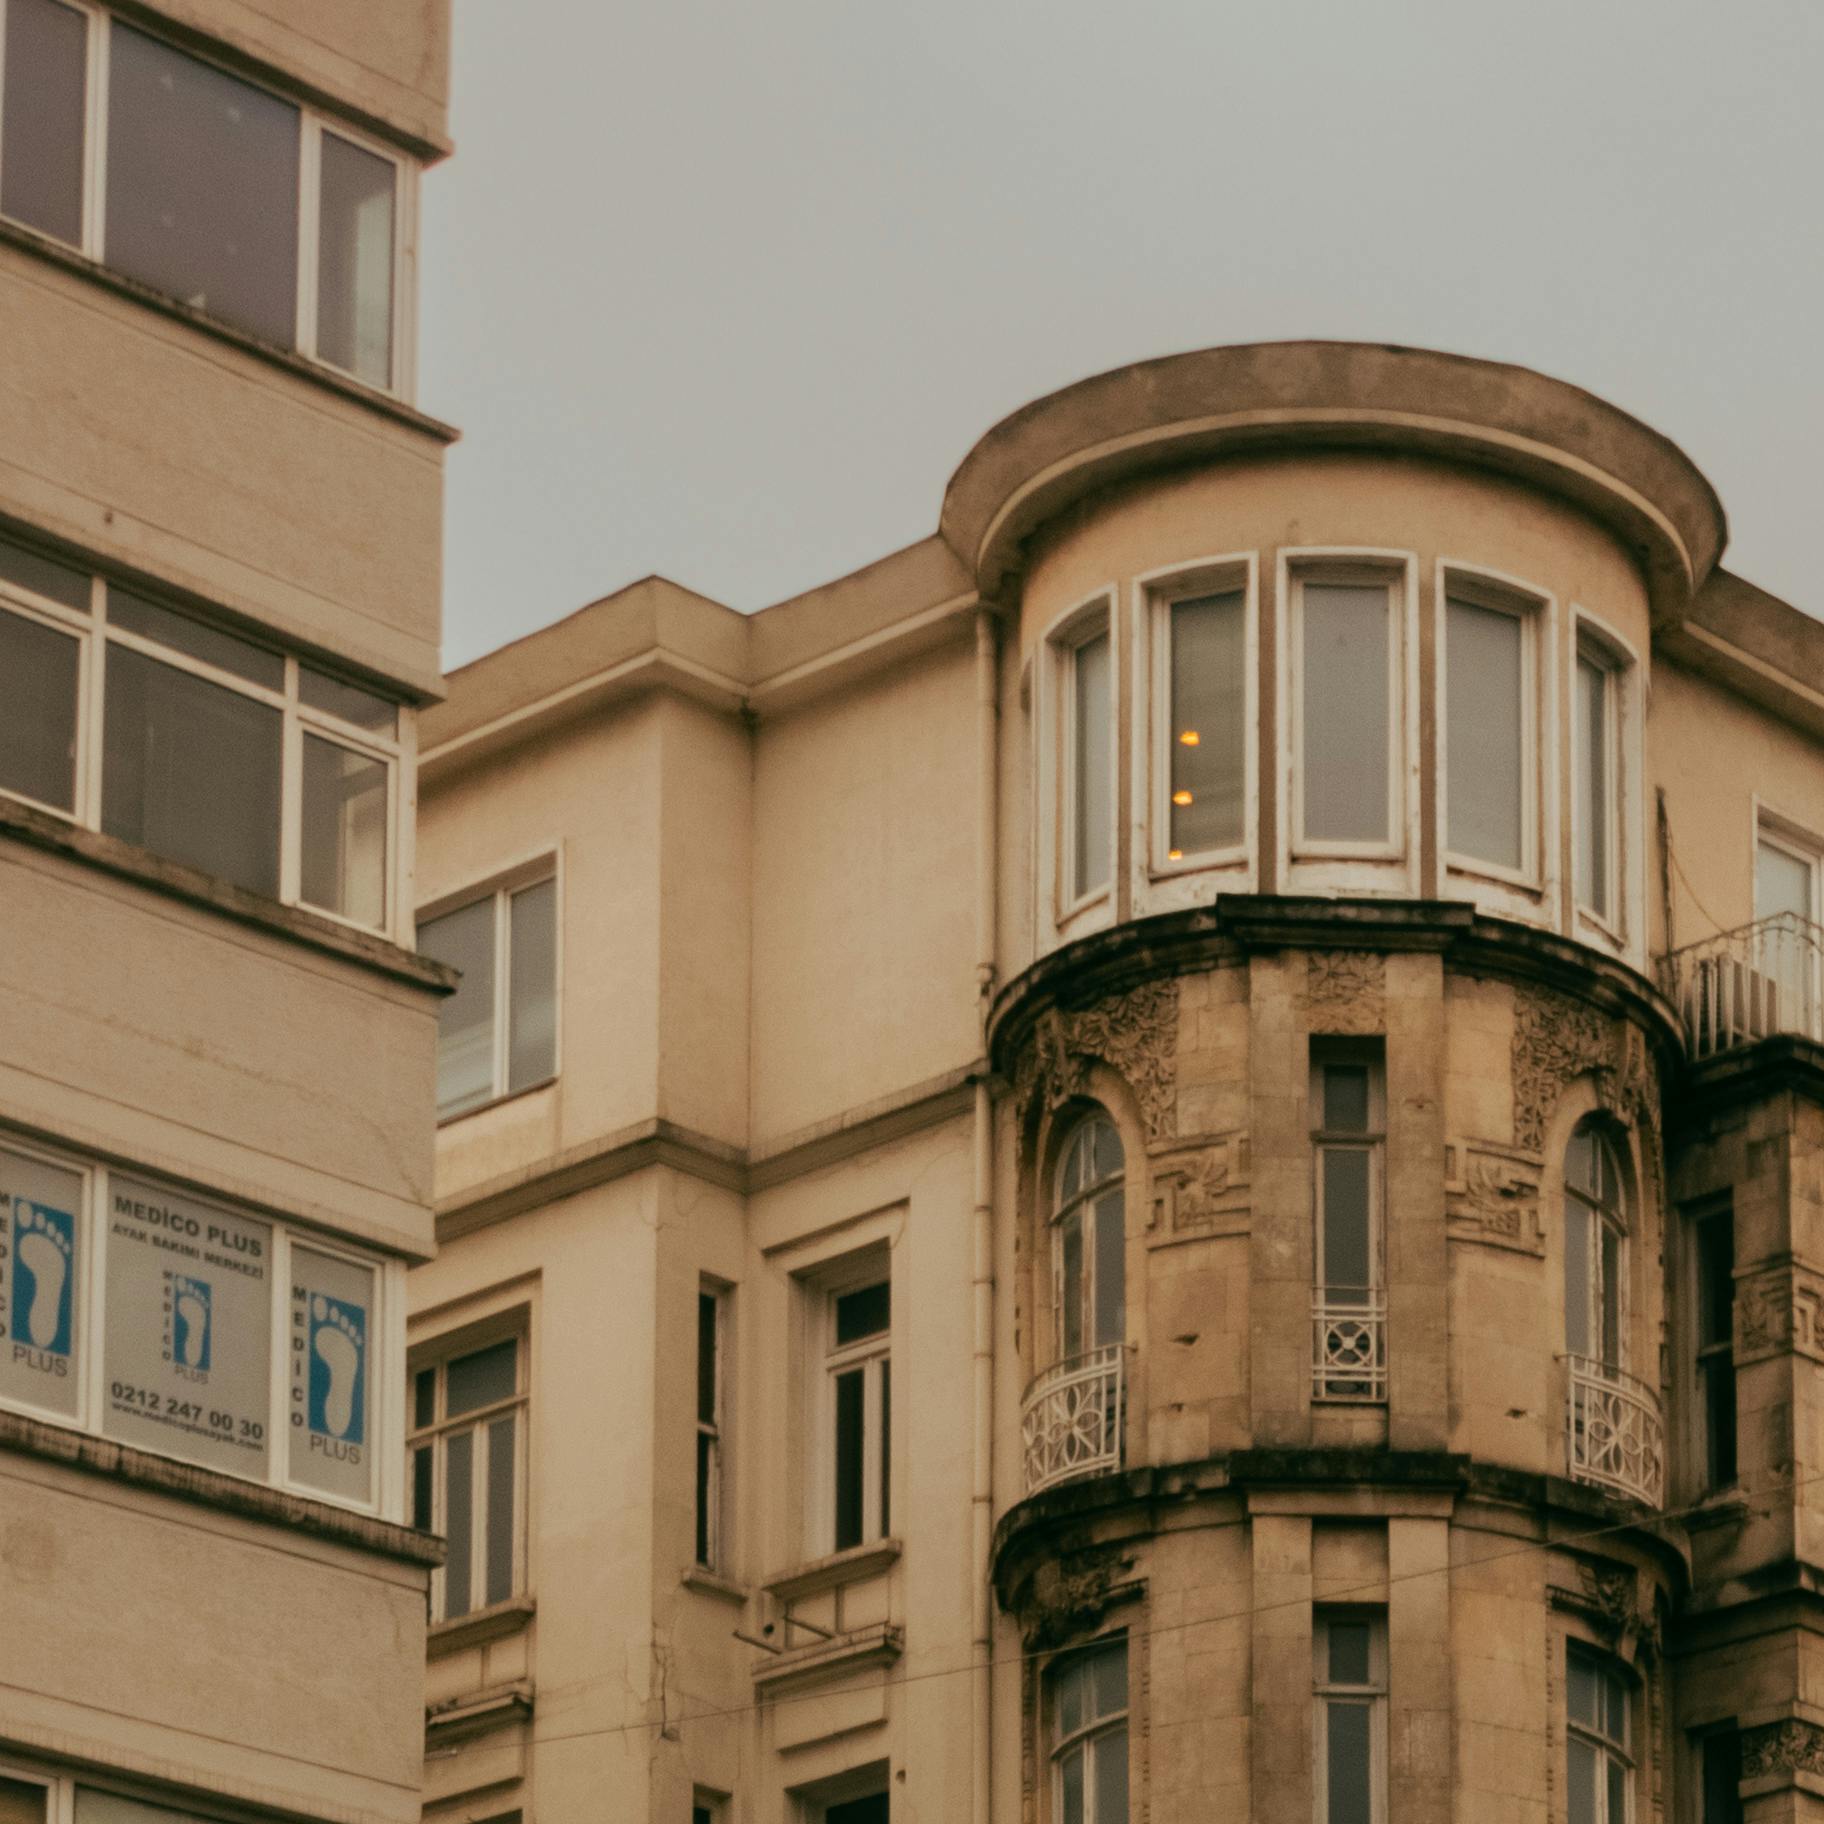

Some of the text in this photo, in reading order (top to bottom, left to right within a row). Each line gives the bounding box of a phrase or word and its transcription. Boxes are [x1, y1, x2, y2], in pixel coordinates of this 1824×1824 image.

[114, 1196, 262, 1257] MEDİCO PLUS
[13, 1345, 68, 1377] PLUS
[175, 1364, 209, 1385] PLUS
[111, 1382, 263, 1439] 0212 247 00 30
[310, 1434, 362, 1465] PLUS
